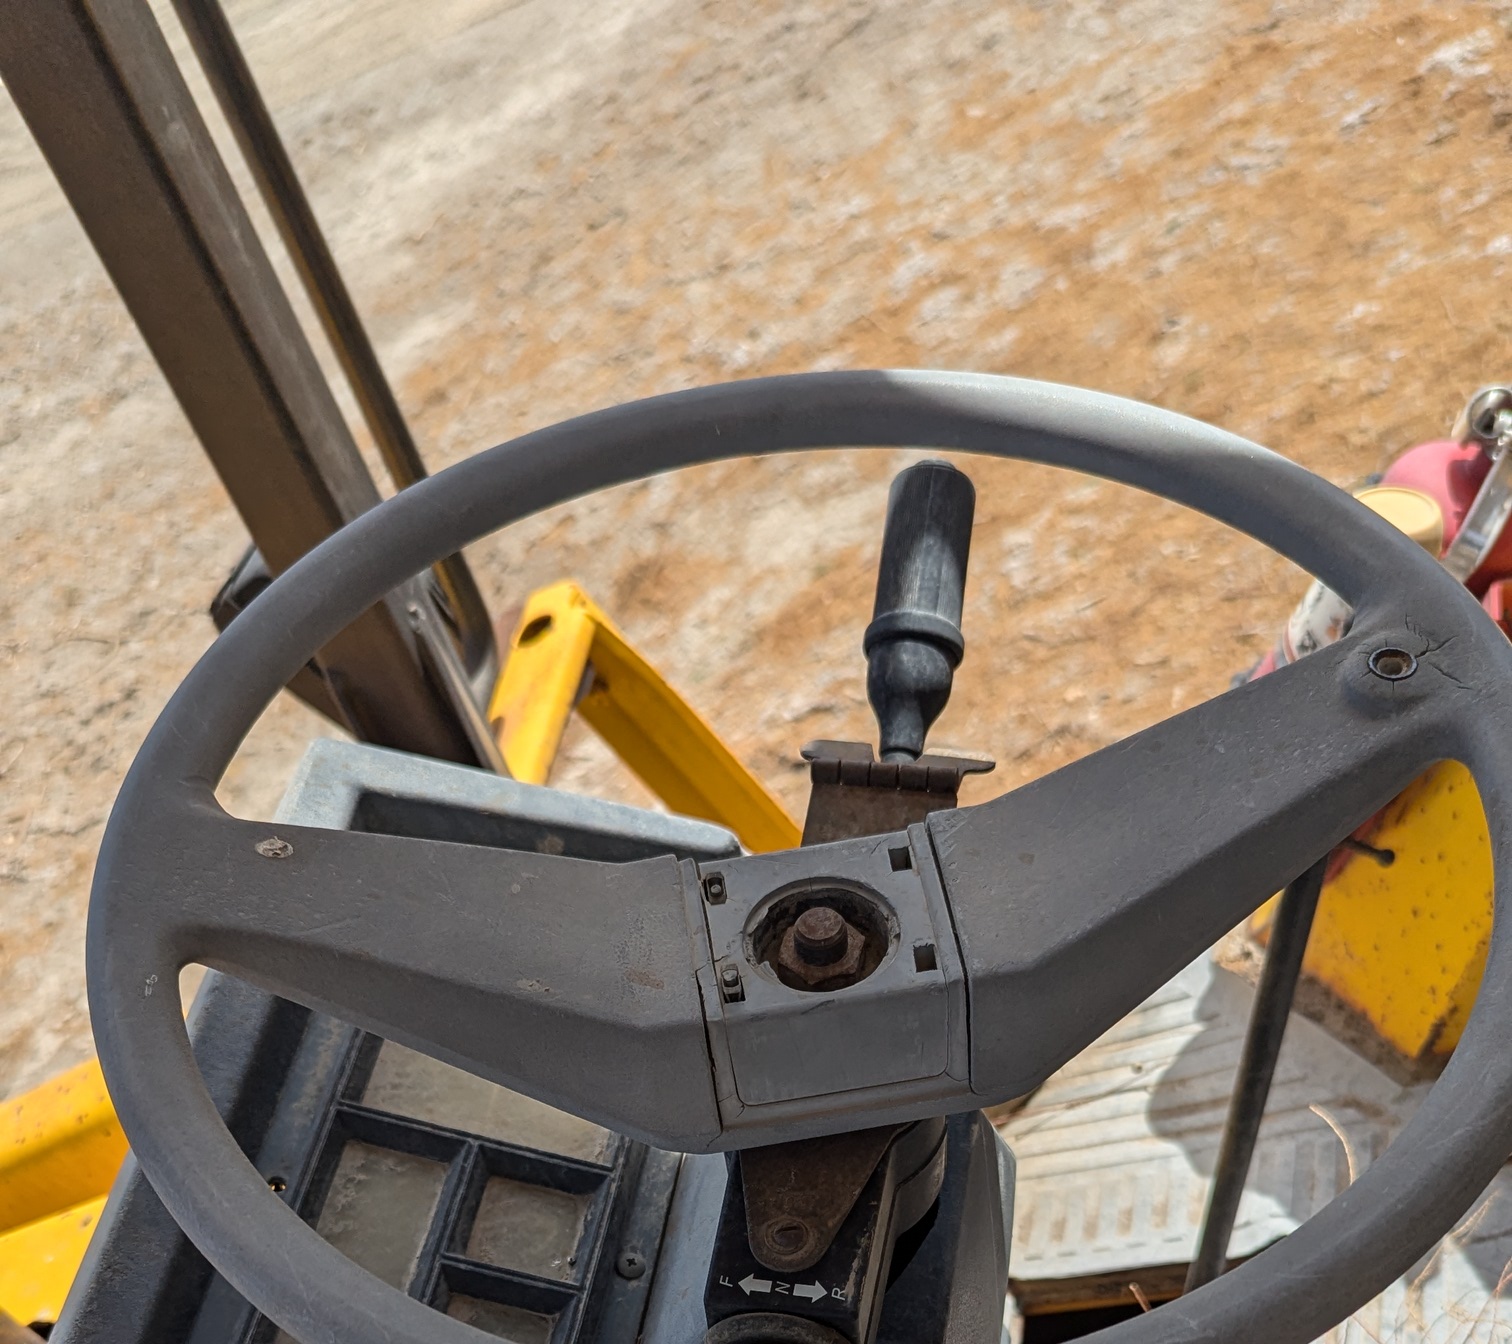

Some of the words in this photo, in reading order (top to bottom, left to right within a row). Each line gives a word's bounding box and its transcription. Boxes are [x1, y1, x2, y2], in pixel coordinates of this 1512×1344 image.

[719, 1275, 733, 1288] F
[775, 1281, 791, 1295] N
[831, 1287, 846, 1301] R
